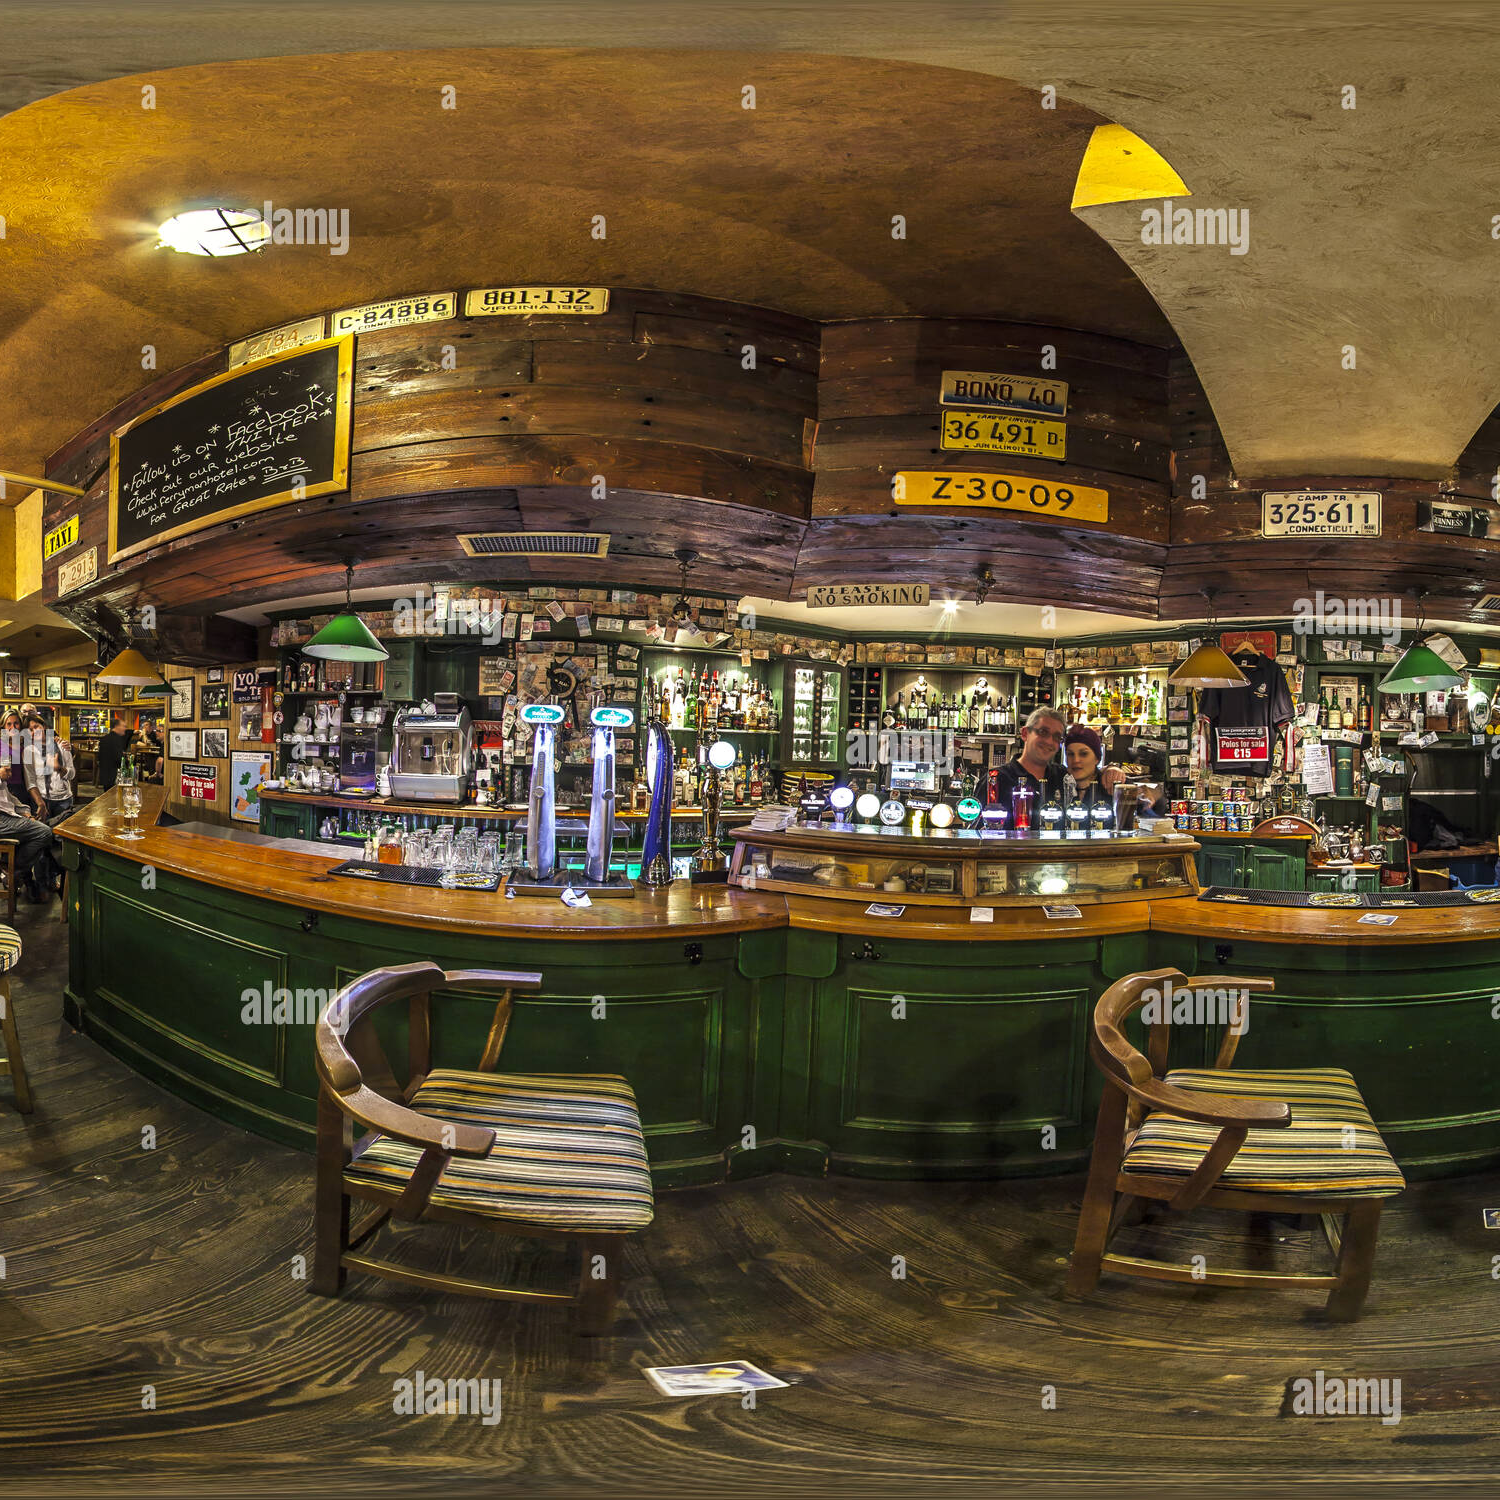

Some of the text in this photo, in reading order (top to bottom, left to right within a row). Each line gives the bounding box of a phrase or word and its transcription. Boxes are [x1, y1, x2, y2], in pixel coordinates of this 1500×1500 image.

[484, 289, 591, 305] 881-132
[340, 299, 447, 329] C-84886
[358, 316, 425, 330] CONNECTICUT
[1029, 387, 1056, 406] 40
[948, 420, 1058, 446] 36 491 D
[992, 444, 1025, 452] ILLINOIS
[127, 490, 157, 512] Check
[162, 477, 182, 493] out
[225, 432, 298, 465] website
[131, 465, 167, 491] Follow
[172, 453, 191, 467] us
[136, 456, 275, 520] www.ferrymanhotel.com
[932, 477, 1074, 511] Z-30-09
[172, 493, 211, 515] GREAT
[50, 526, 72, 552] TAXI
[1289, 525, 1353, 533] CONNECTICUT
[813, 585, 923, 606] NO SMOKING
[817, 585, 885, 594] PLEASE
[1234, 748, 1251, 758] €15
[183, 779, 196, 787] Polos
[204, 781, 215, 789] sale
[191, 787, 204, 798] €15
